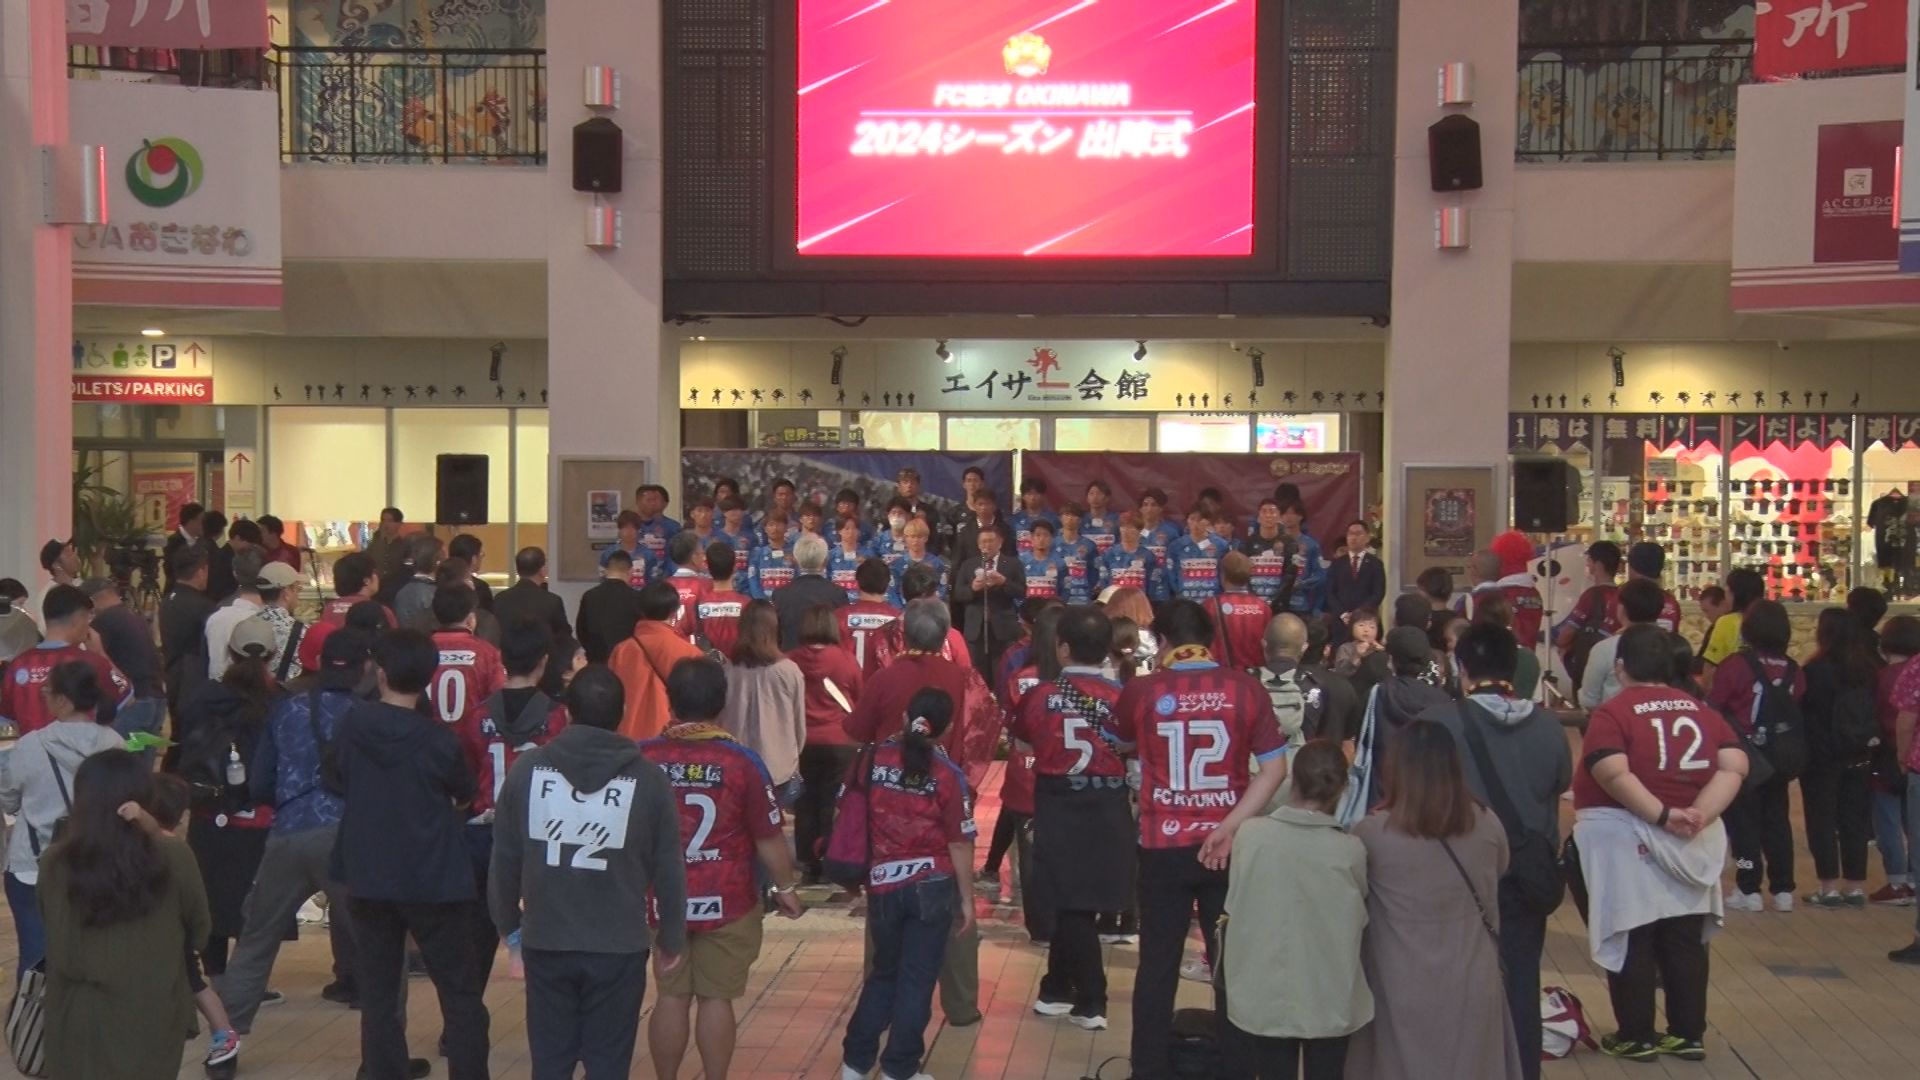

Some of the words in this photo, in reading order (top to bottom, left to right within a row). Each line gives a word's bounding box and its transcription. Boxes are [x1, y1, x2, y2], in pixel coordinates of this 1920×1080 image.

[1015, 83, 1131, 106] OKINAWA
[850, 120, 1074, 155] 2024シーズン
[72, 382, 206, 397] ILETS/PARKING
[1063, 718, 1093, 775] 5
[1156, 720, 1231, 791] 12
[1651, 716, 1710, 771] 12
[1153, 788, 1172, 805] FC
[1174, 791, 1237, 807] RYUKYU
[684, 793, 720, 857] 2
[890, 862, 932, 877] JTA
[691, 901, 720, 915] TA
